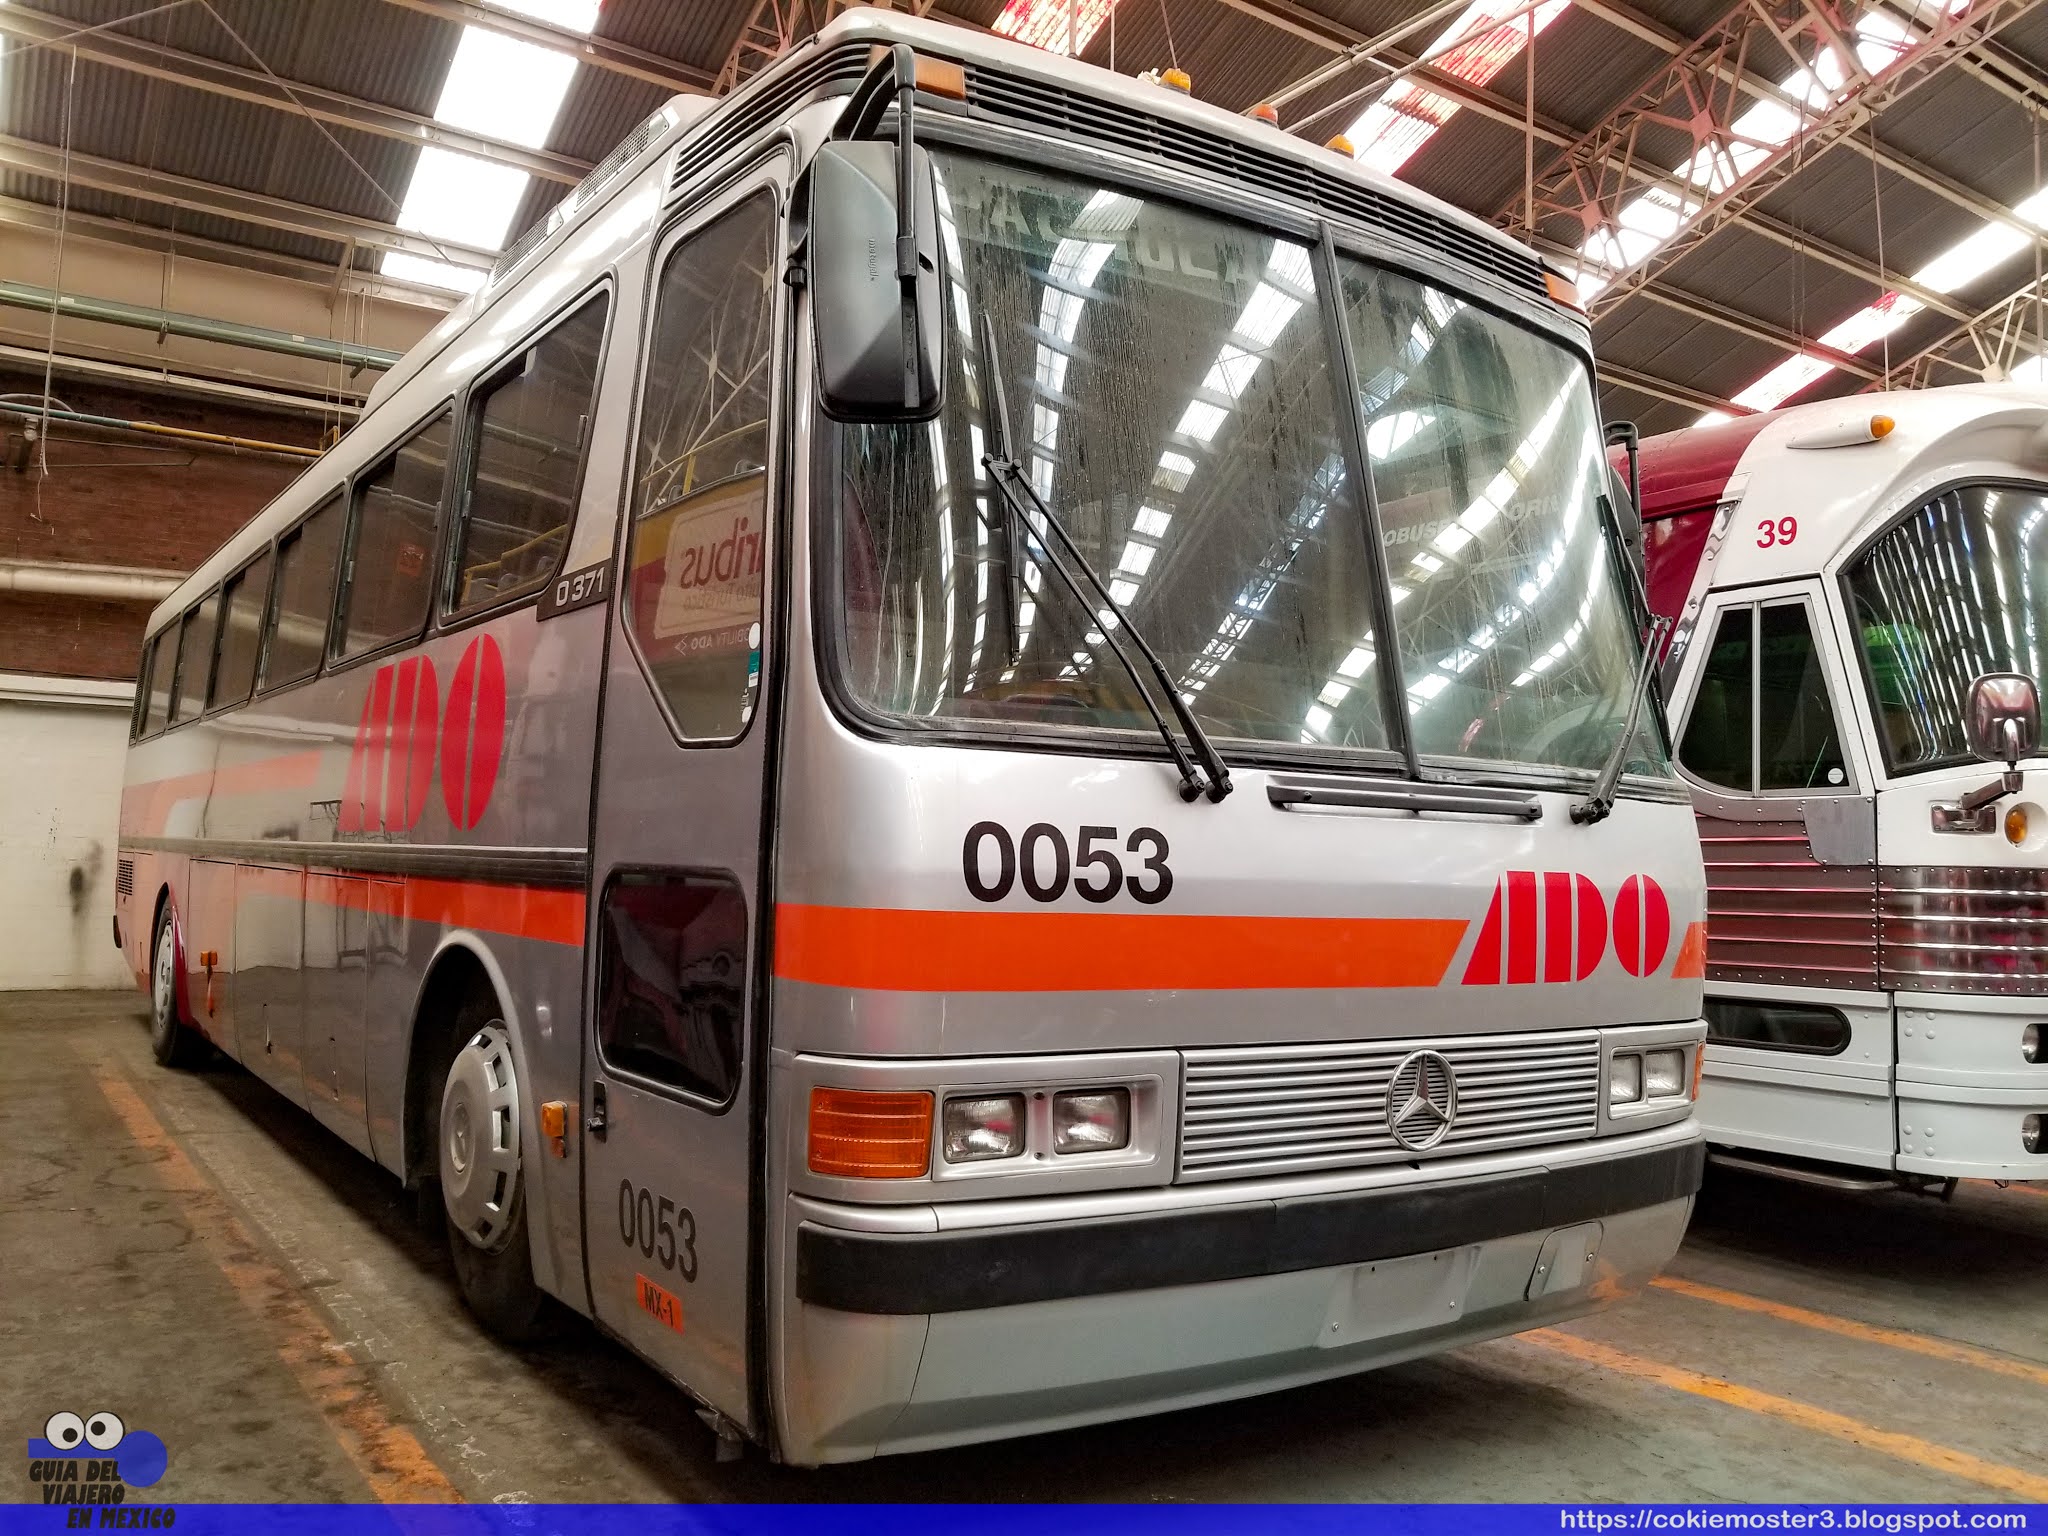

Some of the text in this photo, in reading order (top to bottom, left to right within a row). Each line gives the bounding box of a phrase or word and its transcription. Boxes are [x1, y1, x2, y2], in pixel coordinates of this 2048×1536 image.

[1756, 516, 1798, 549] 39
[571, 566, 605, 602] 371
[337, 633, 507, 833] ADO
[962, 820, 1174, 905] 0053
[1461, 870, 1671, 985] ADO
[618, 1178, 699, 1284] 0053
[643, 1282, 675, 1328] MX-1
